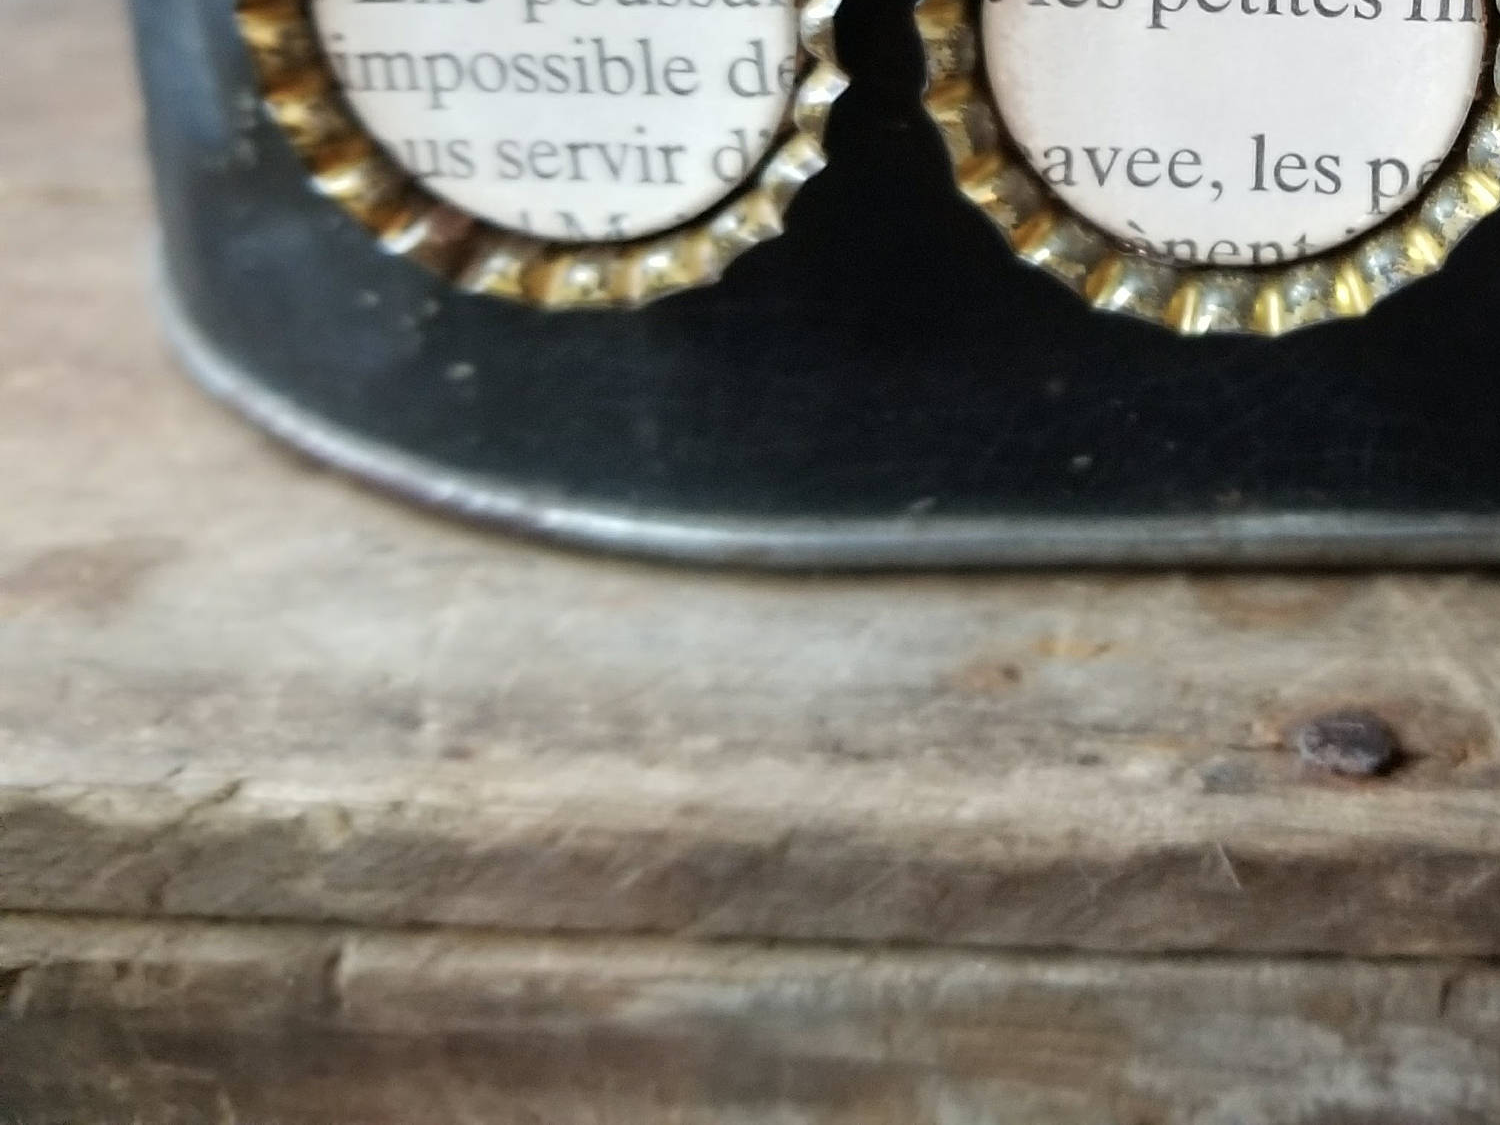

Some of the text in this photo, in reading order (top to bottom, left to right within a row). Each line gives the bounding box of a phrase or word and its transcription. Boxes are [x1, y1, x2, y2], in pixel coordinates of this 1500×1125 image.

[335, 34, 698, 110] impossible
[495, 126, 688, 185] servir
[1022, 142, 1222, 203] avee,
[1250, 133, 1342, 195] les
